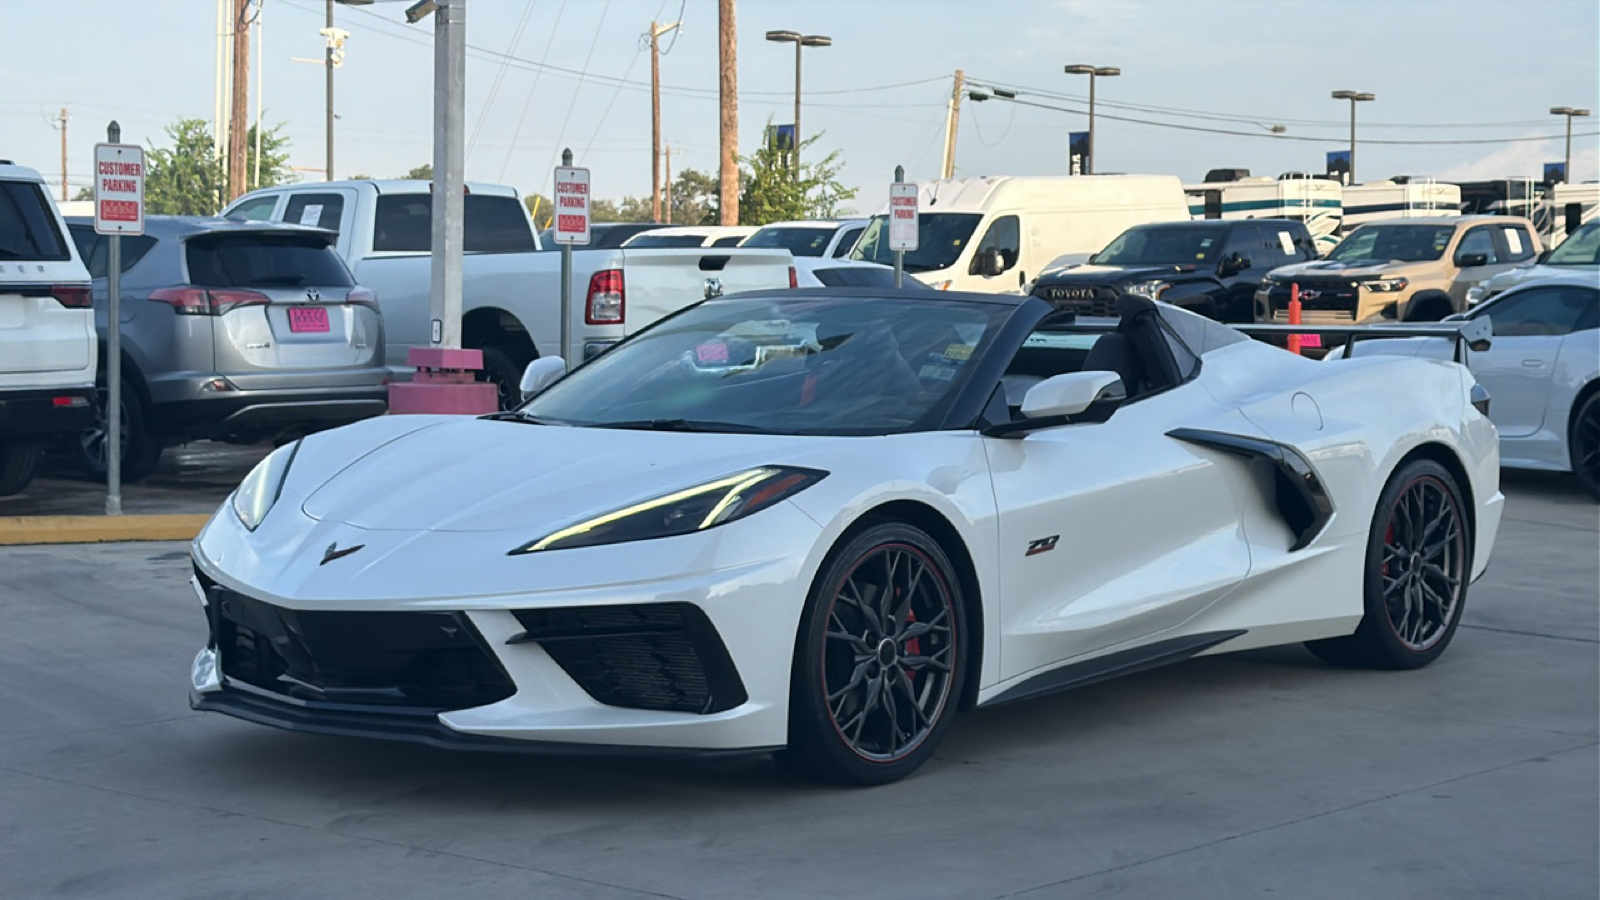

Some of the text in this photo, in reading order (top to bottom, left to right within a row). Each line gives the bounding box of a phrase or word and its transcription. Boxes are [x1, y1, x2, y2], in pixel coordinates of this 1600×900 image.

[99, 161, 141, 176] CUSTOMER
[102, 178, 137, 193] PARKING
[557, 181, 588, 195] CUSTOMER
[559, 196, 585, 208] PARKING
[892, 196, 917, 206] CUSTOMER
[894, 209, 915, 220] PARKING
[1051, 288, 1095, 299] TOYOTA
